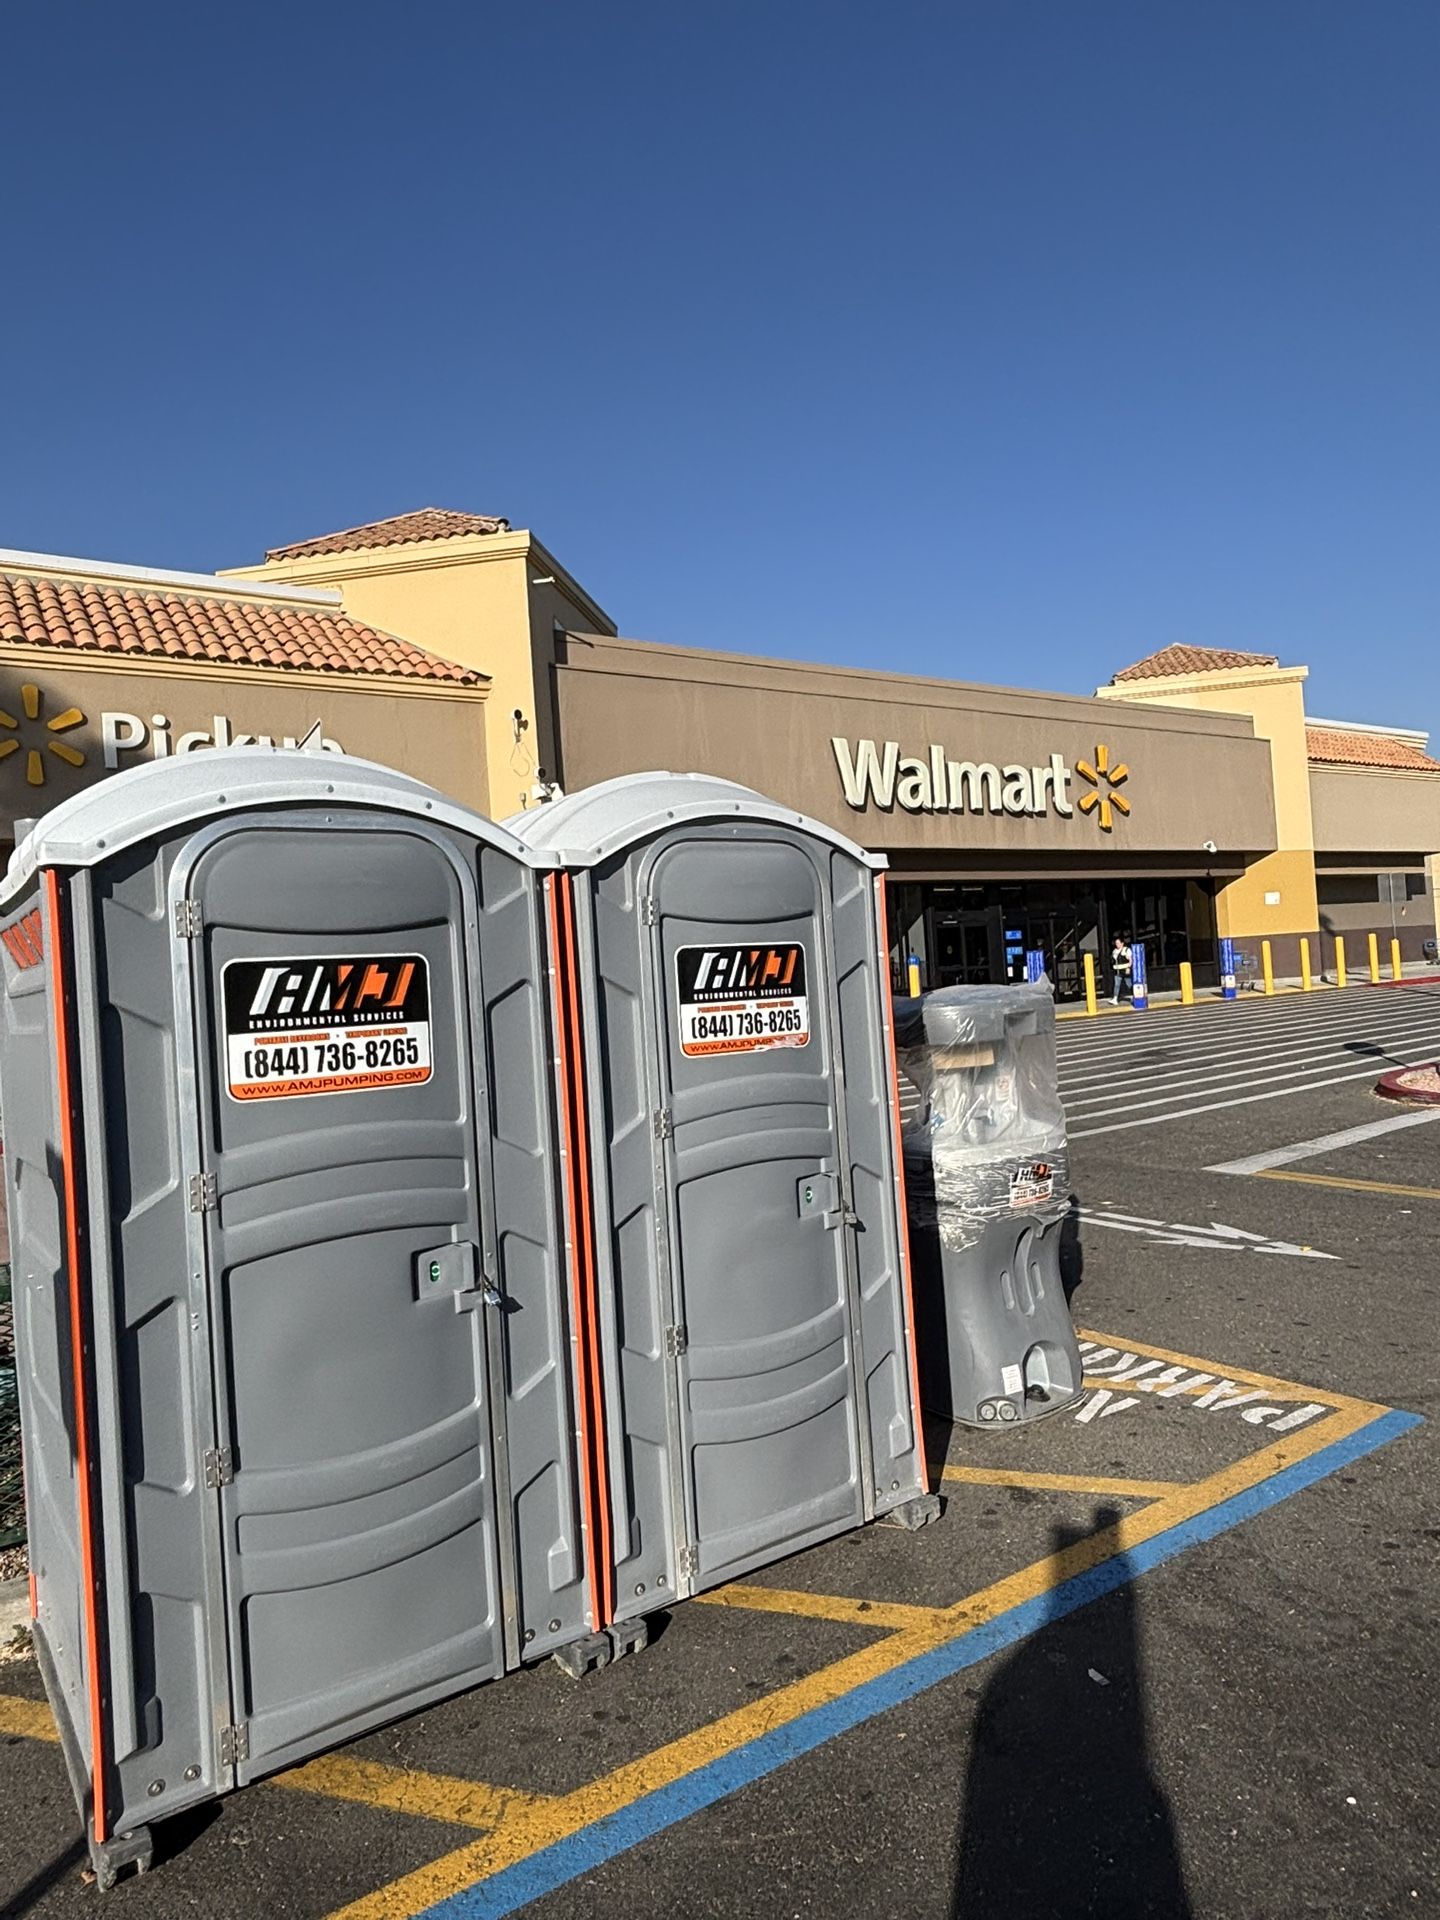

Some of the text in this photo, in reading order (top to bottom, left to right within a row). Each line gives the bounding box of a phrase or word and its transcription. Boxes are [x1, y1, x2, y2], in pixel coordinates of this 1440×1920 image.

[831, 737, 1073, 816] Walmart
[249, 1011, 404, 1029] ENVIRONMENTAL SERVICES
[691, 1009, 801, 1039] (844) 736-8265
[244, 1037, 419, 1078] (844) 736-8265
[242, 1071, 423, 1096] WWW.AMJPUMPING.COM
